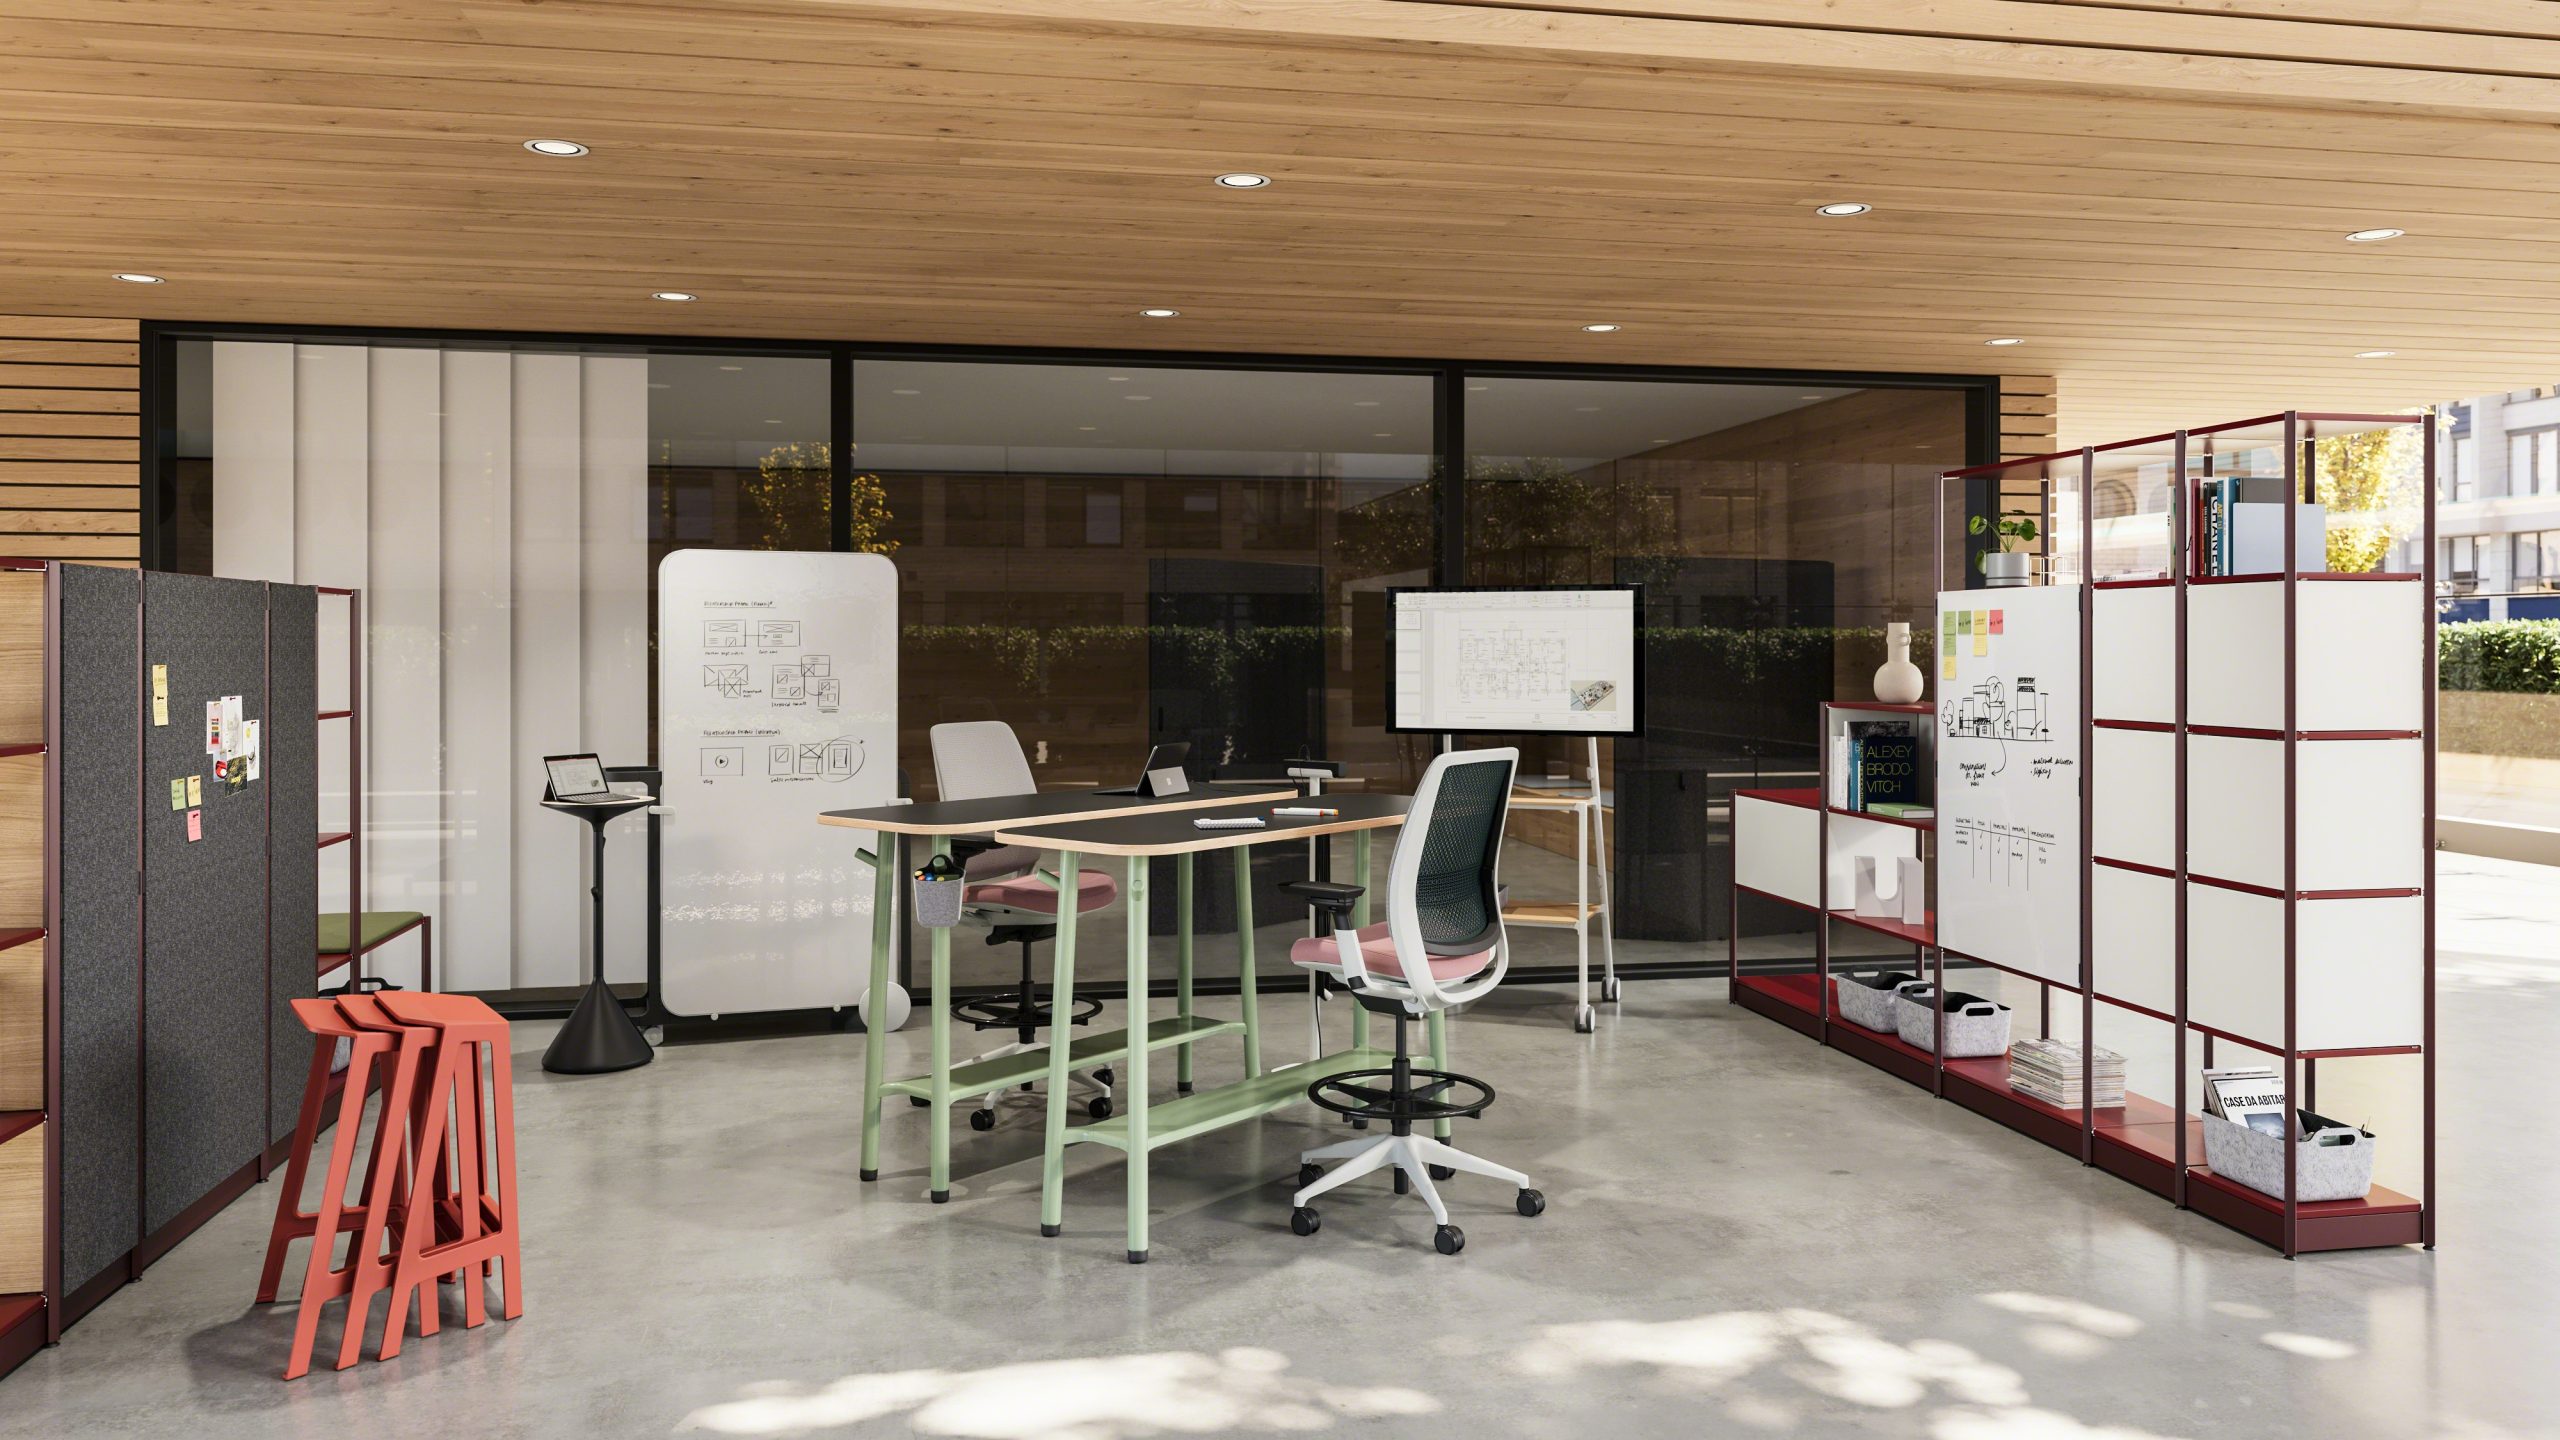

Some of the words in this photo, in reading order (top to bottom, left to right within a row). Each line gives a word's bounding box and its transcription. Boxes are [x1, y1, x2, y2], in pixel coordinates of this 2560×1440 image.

[1866, 745, 1913, 758] ALEXEY
[1866, 762, 1914, 776] BRODO-
[1866, 780, 1901, 793] VITCH
[2223, 1096, 2246, 1108] CASE
[2245, 1095, 2258, 1107] DA
